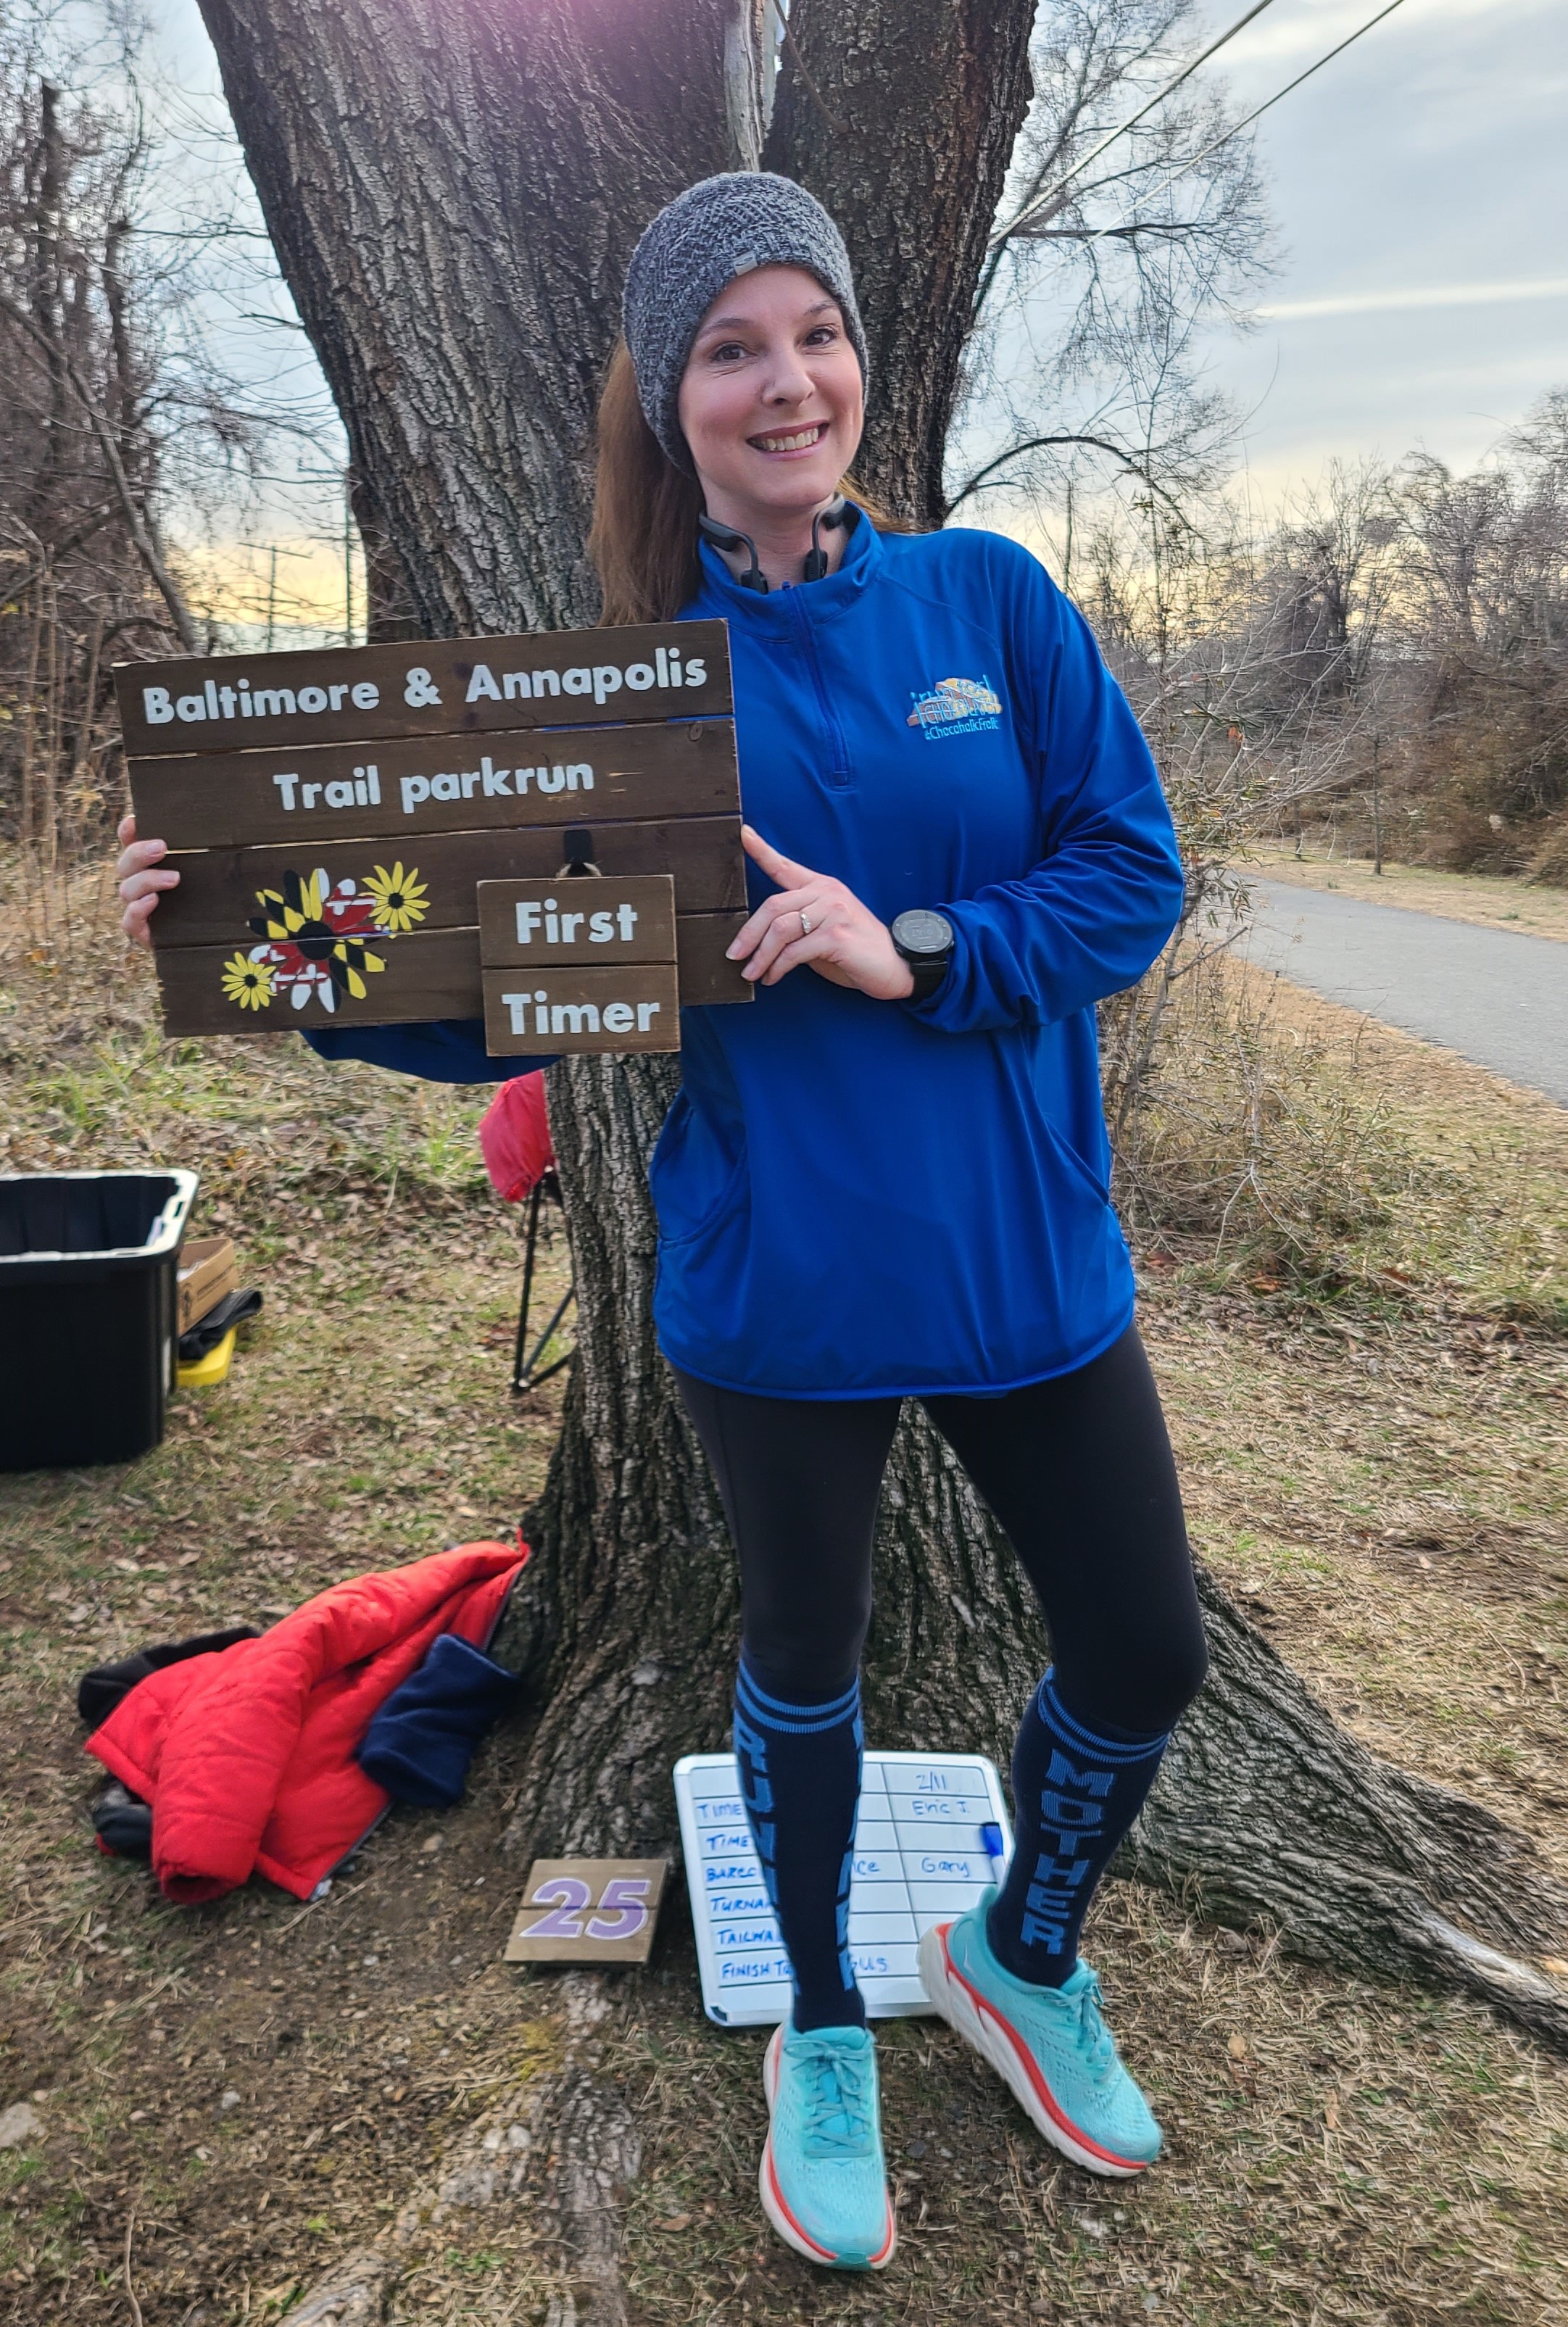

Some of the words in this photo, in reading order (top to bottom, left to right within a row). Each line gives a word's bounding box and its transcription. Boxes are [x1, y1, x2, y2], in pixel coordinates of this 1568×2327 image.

[143, 679, 379, 725] Baltimore
[404, 667, 442, 708] &
[465, 647, 708, 705] Annapolis
[273, 765, 382, 811] Trail
[400, 756, 594, 814] parkrun
[515, 899, 639, 944] First
[501, 990, 661, 1035] Timer
[912, 1799, 951, 1814] Eric
[706, 1833, 750, 1850] TIME
[1021, 1748, 1115, 1955] MOTHER
[519, 1878, 652, 1940] 25
[710, 1896, 771, 1912] TURNA
[717, 1928, 781, 1944] TAILWA
[722, 1962, 770, 1979] FINISH
